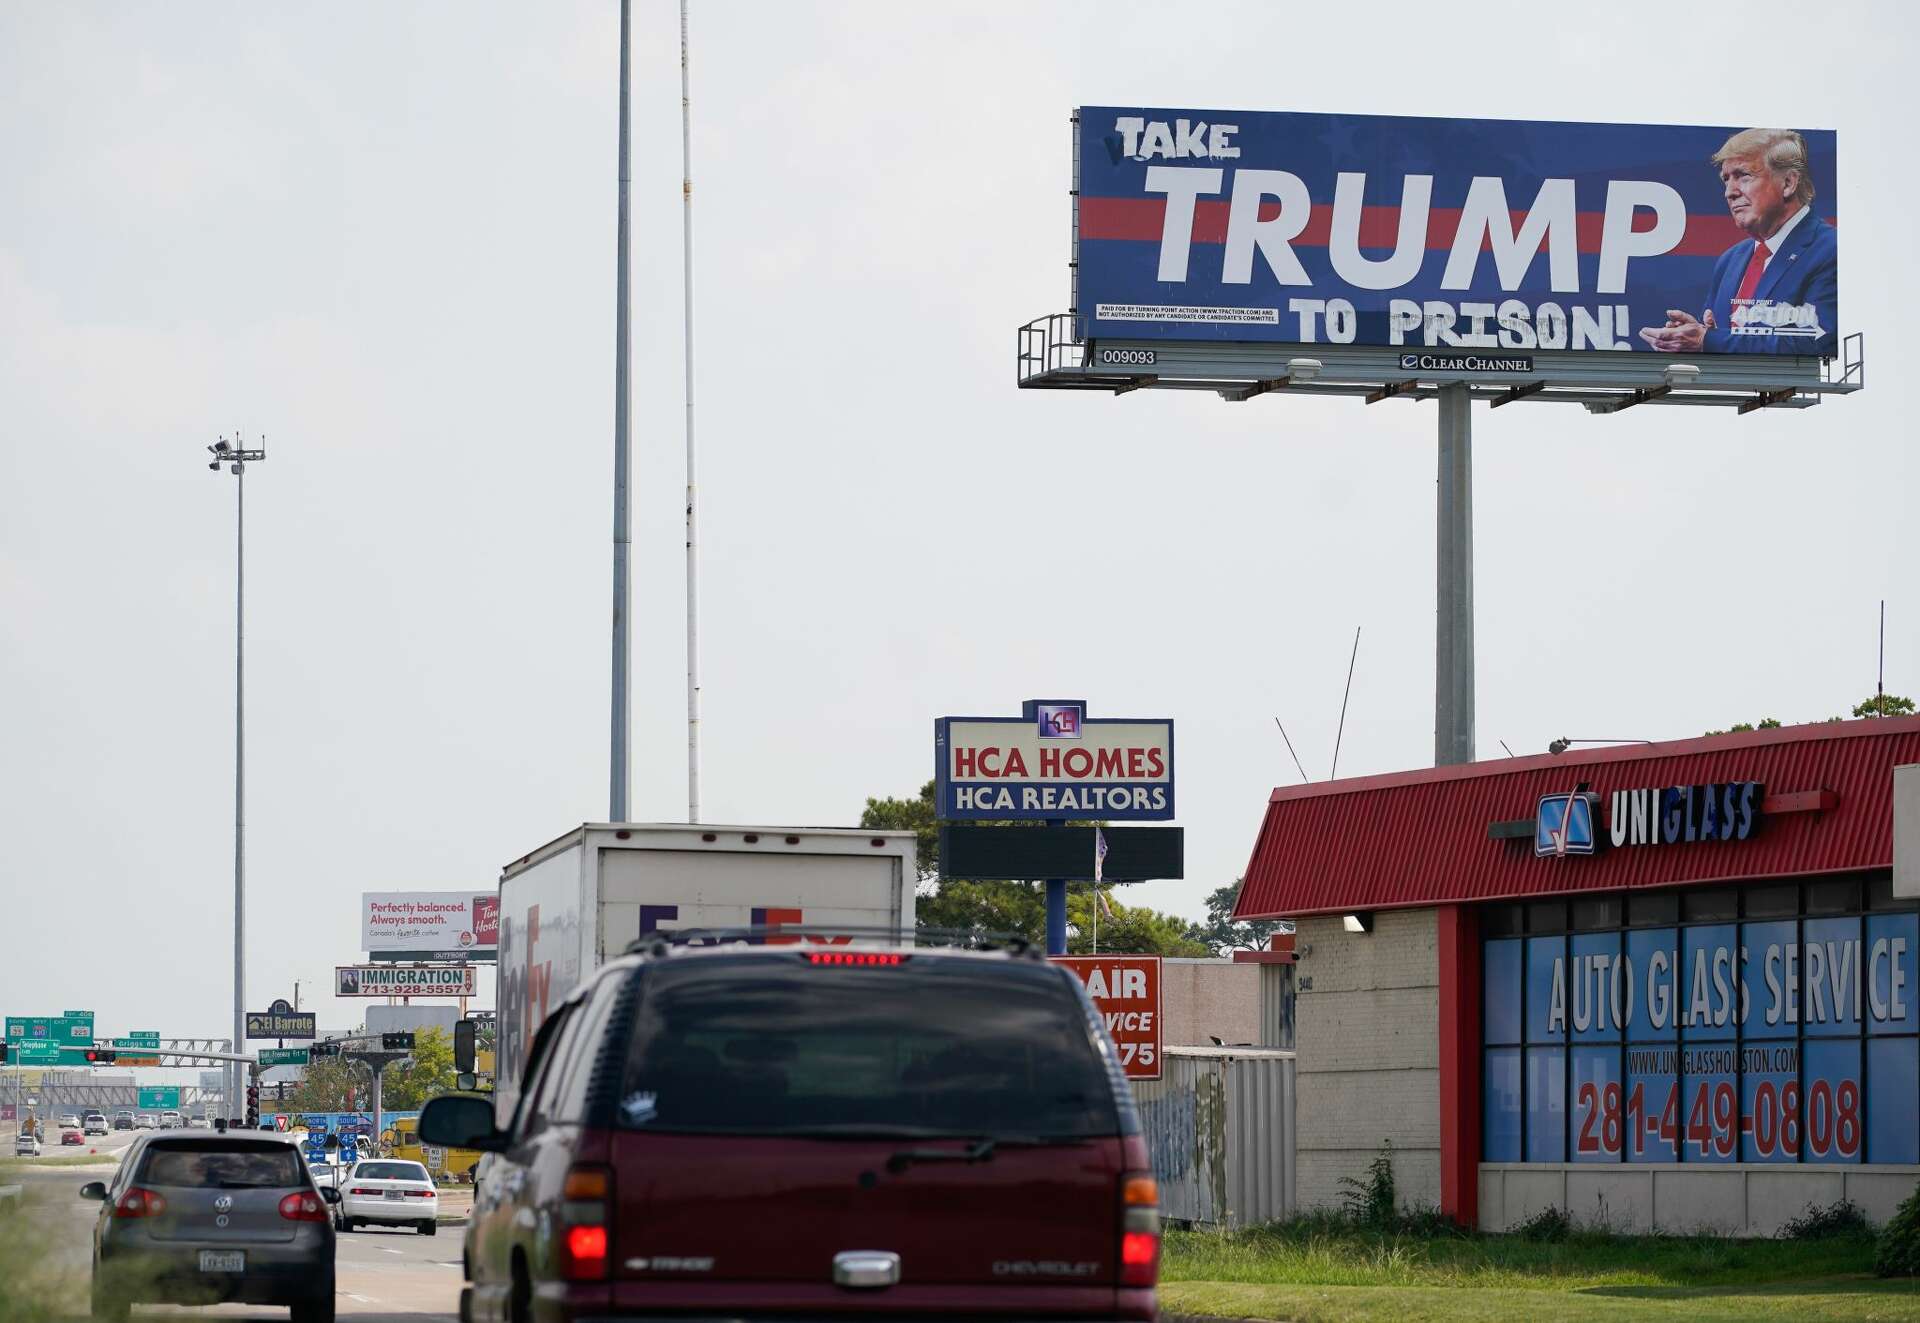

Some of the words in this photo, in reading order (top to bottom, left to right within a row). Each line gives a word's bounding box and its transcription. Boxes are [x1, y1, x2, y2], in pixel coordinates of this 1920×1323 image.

[1115, 117, 1241, 159] TAKE
[1144, 166, 1687, 293] TRUMP
[1289, 298, 1357, 343] TO
[1389, 299, 1632, 351] PRISON!
[1103, 351, 1154, 364] 009093
[955, 747, 1029, 777] HCA
[1040, 747, 1164, 778] HOMES
[956, 787, 1018, 809] HCA
[1023, 787, 1166, 810] REALTORS
[1610, 781, 1755, 847] UNIGLASS
[371, 903, 415, 915] Perfectly
[417, 902, 467, 912] balanced.
[370, 915, 406, 927] Always
[408, 915, 447, 925] smooth.
[361, 970, 463, 984] IMMIGRATION
[1086, 969, 1147, 999] AIR
[1548, 953, 1633, 1032] AUTO
[1647, 945, 1750, 1028] GLASS
[1764, 937, 1906, 1025] SERVICE
[362, 985, 463, 994] 713-928-5557
[1104, 1012, 1153, 1032] VICE
[1120, 1043, 1155, 1066] 75
[1629, 1048, 1800, 1075] WWW.UNGLASSHOUSTON.COM
[1577, 1079, 1862, 1158] 281-449-0808
[310, 1134, 325, 1143] 45
[341, 1133, 355, 1143] 45
[992, 1260, 1098, 1275] CHEVROLET
